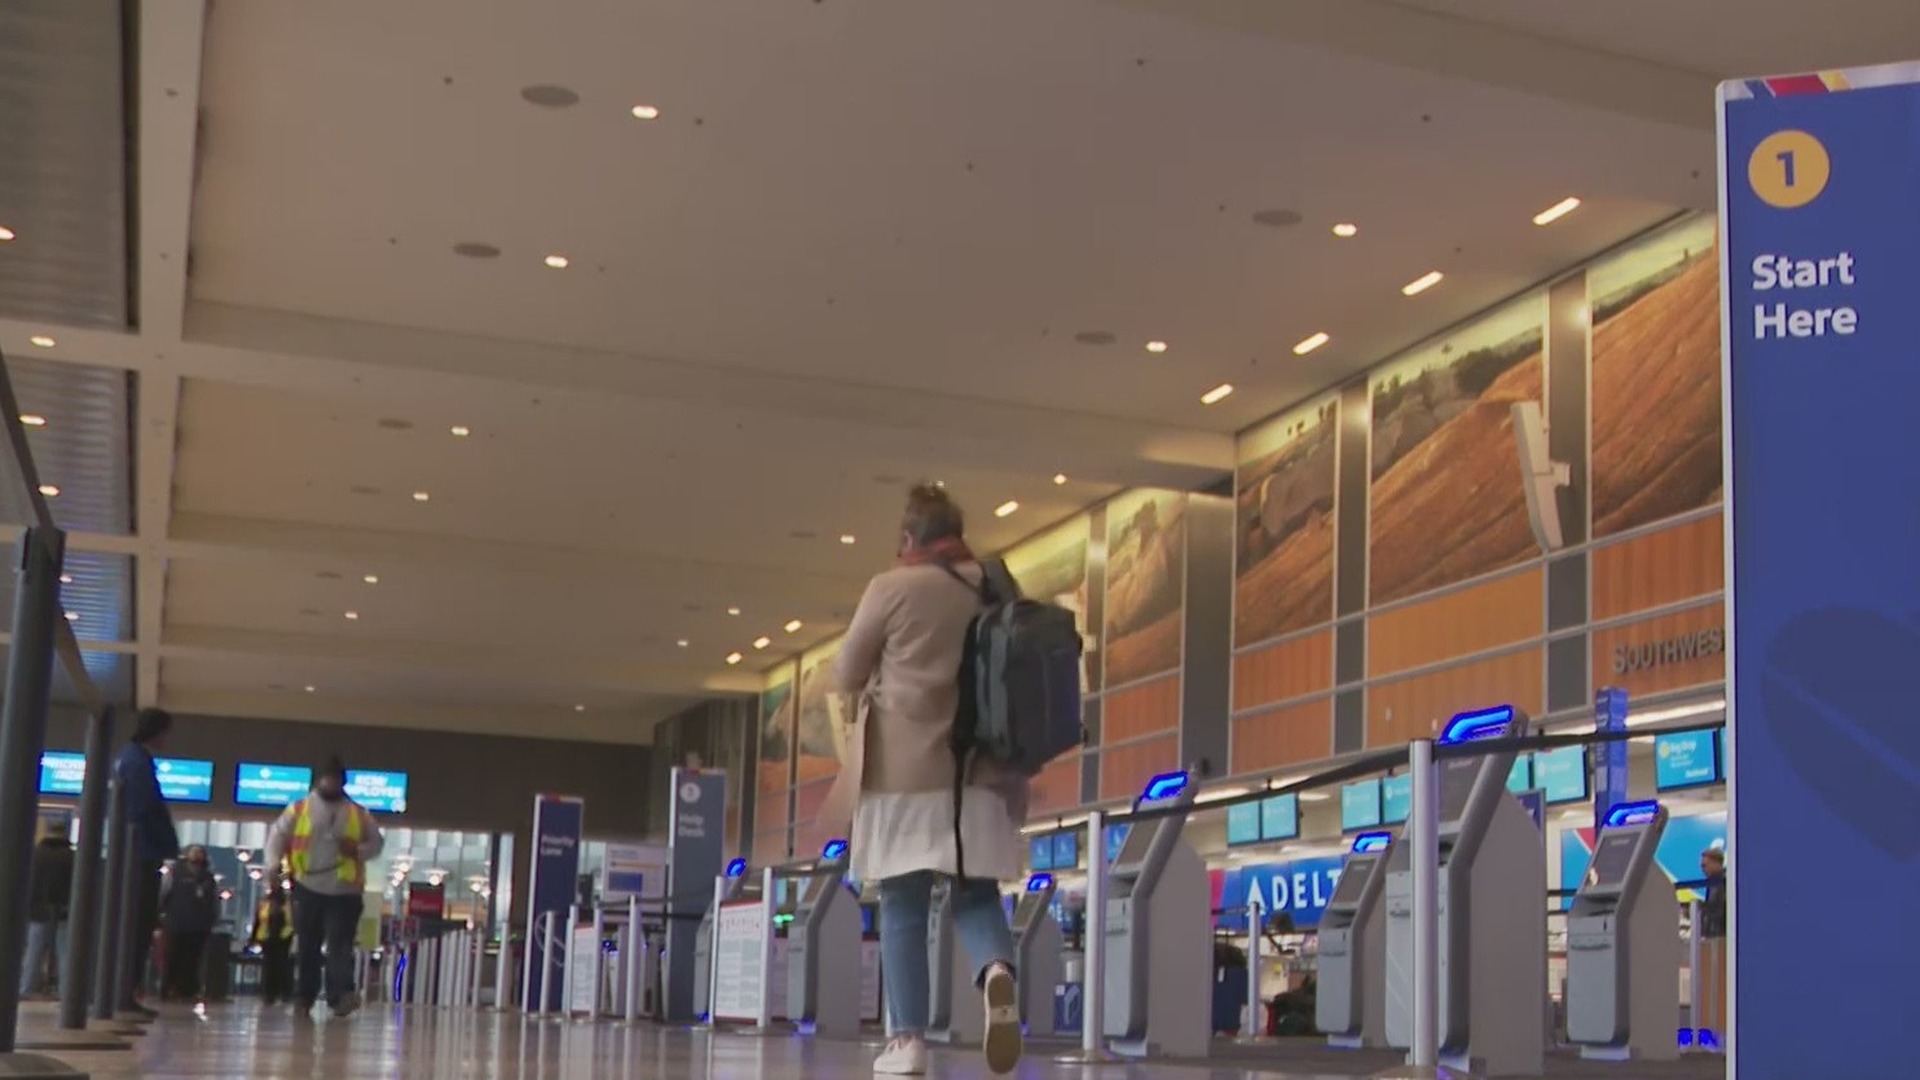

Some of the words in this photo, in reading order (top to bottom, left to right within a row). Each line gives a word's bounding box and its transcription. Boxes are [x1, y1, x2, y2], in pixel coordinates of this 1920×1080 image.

[1776, 149, 1796, 188] 1
[1752, 251, 1855, 290] Start
[1754, 303, 1858, 339] Here
